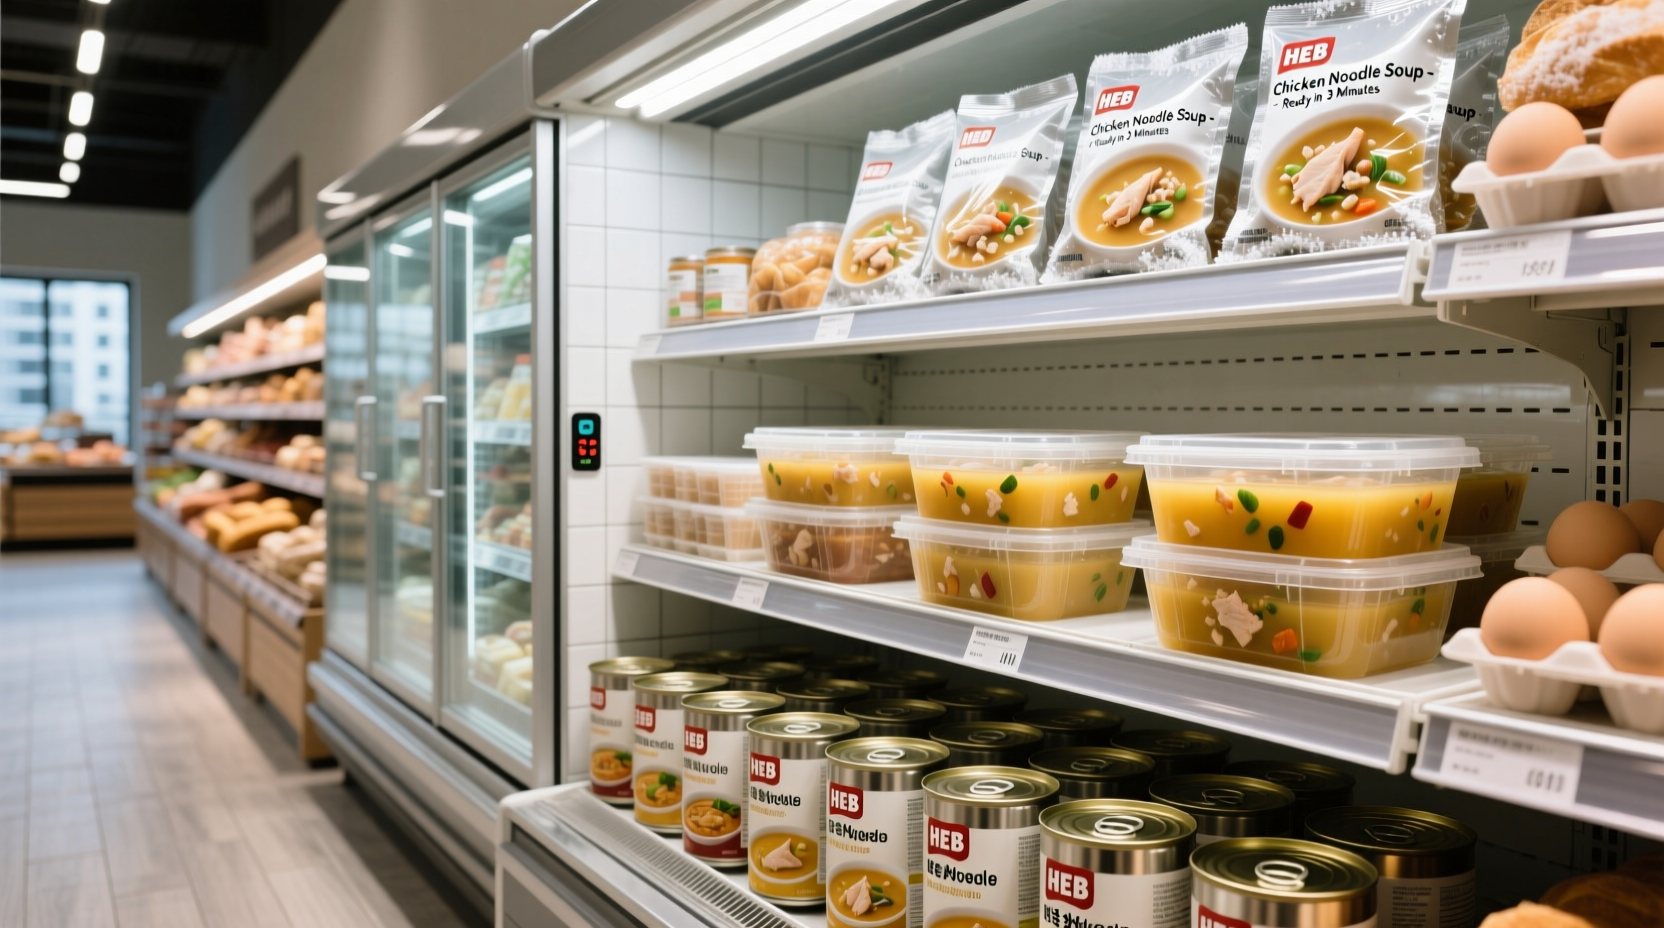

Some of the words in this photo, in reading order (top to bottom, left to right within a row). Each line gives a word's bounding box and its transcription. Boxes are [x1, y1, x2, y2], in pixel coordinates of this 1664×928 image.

[1282, 42, 1329, 66] HEB
[1273, 76, 1325, 96] Chicken
[1328, 64, 1380, 86] Noodle
[1384, 62, 1424, 82] Soup
[1099, 90, 1134, 109] HEB
[1133, 110, 1174, 127] Noodle
[1176, 108, 1207, 126] Soup
[831, 788, 859, 813] HEB
[930, 825, 964, 853] HEB
[1048, 867, 1089, 900] HEB
